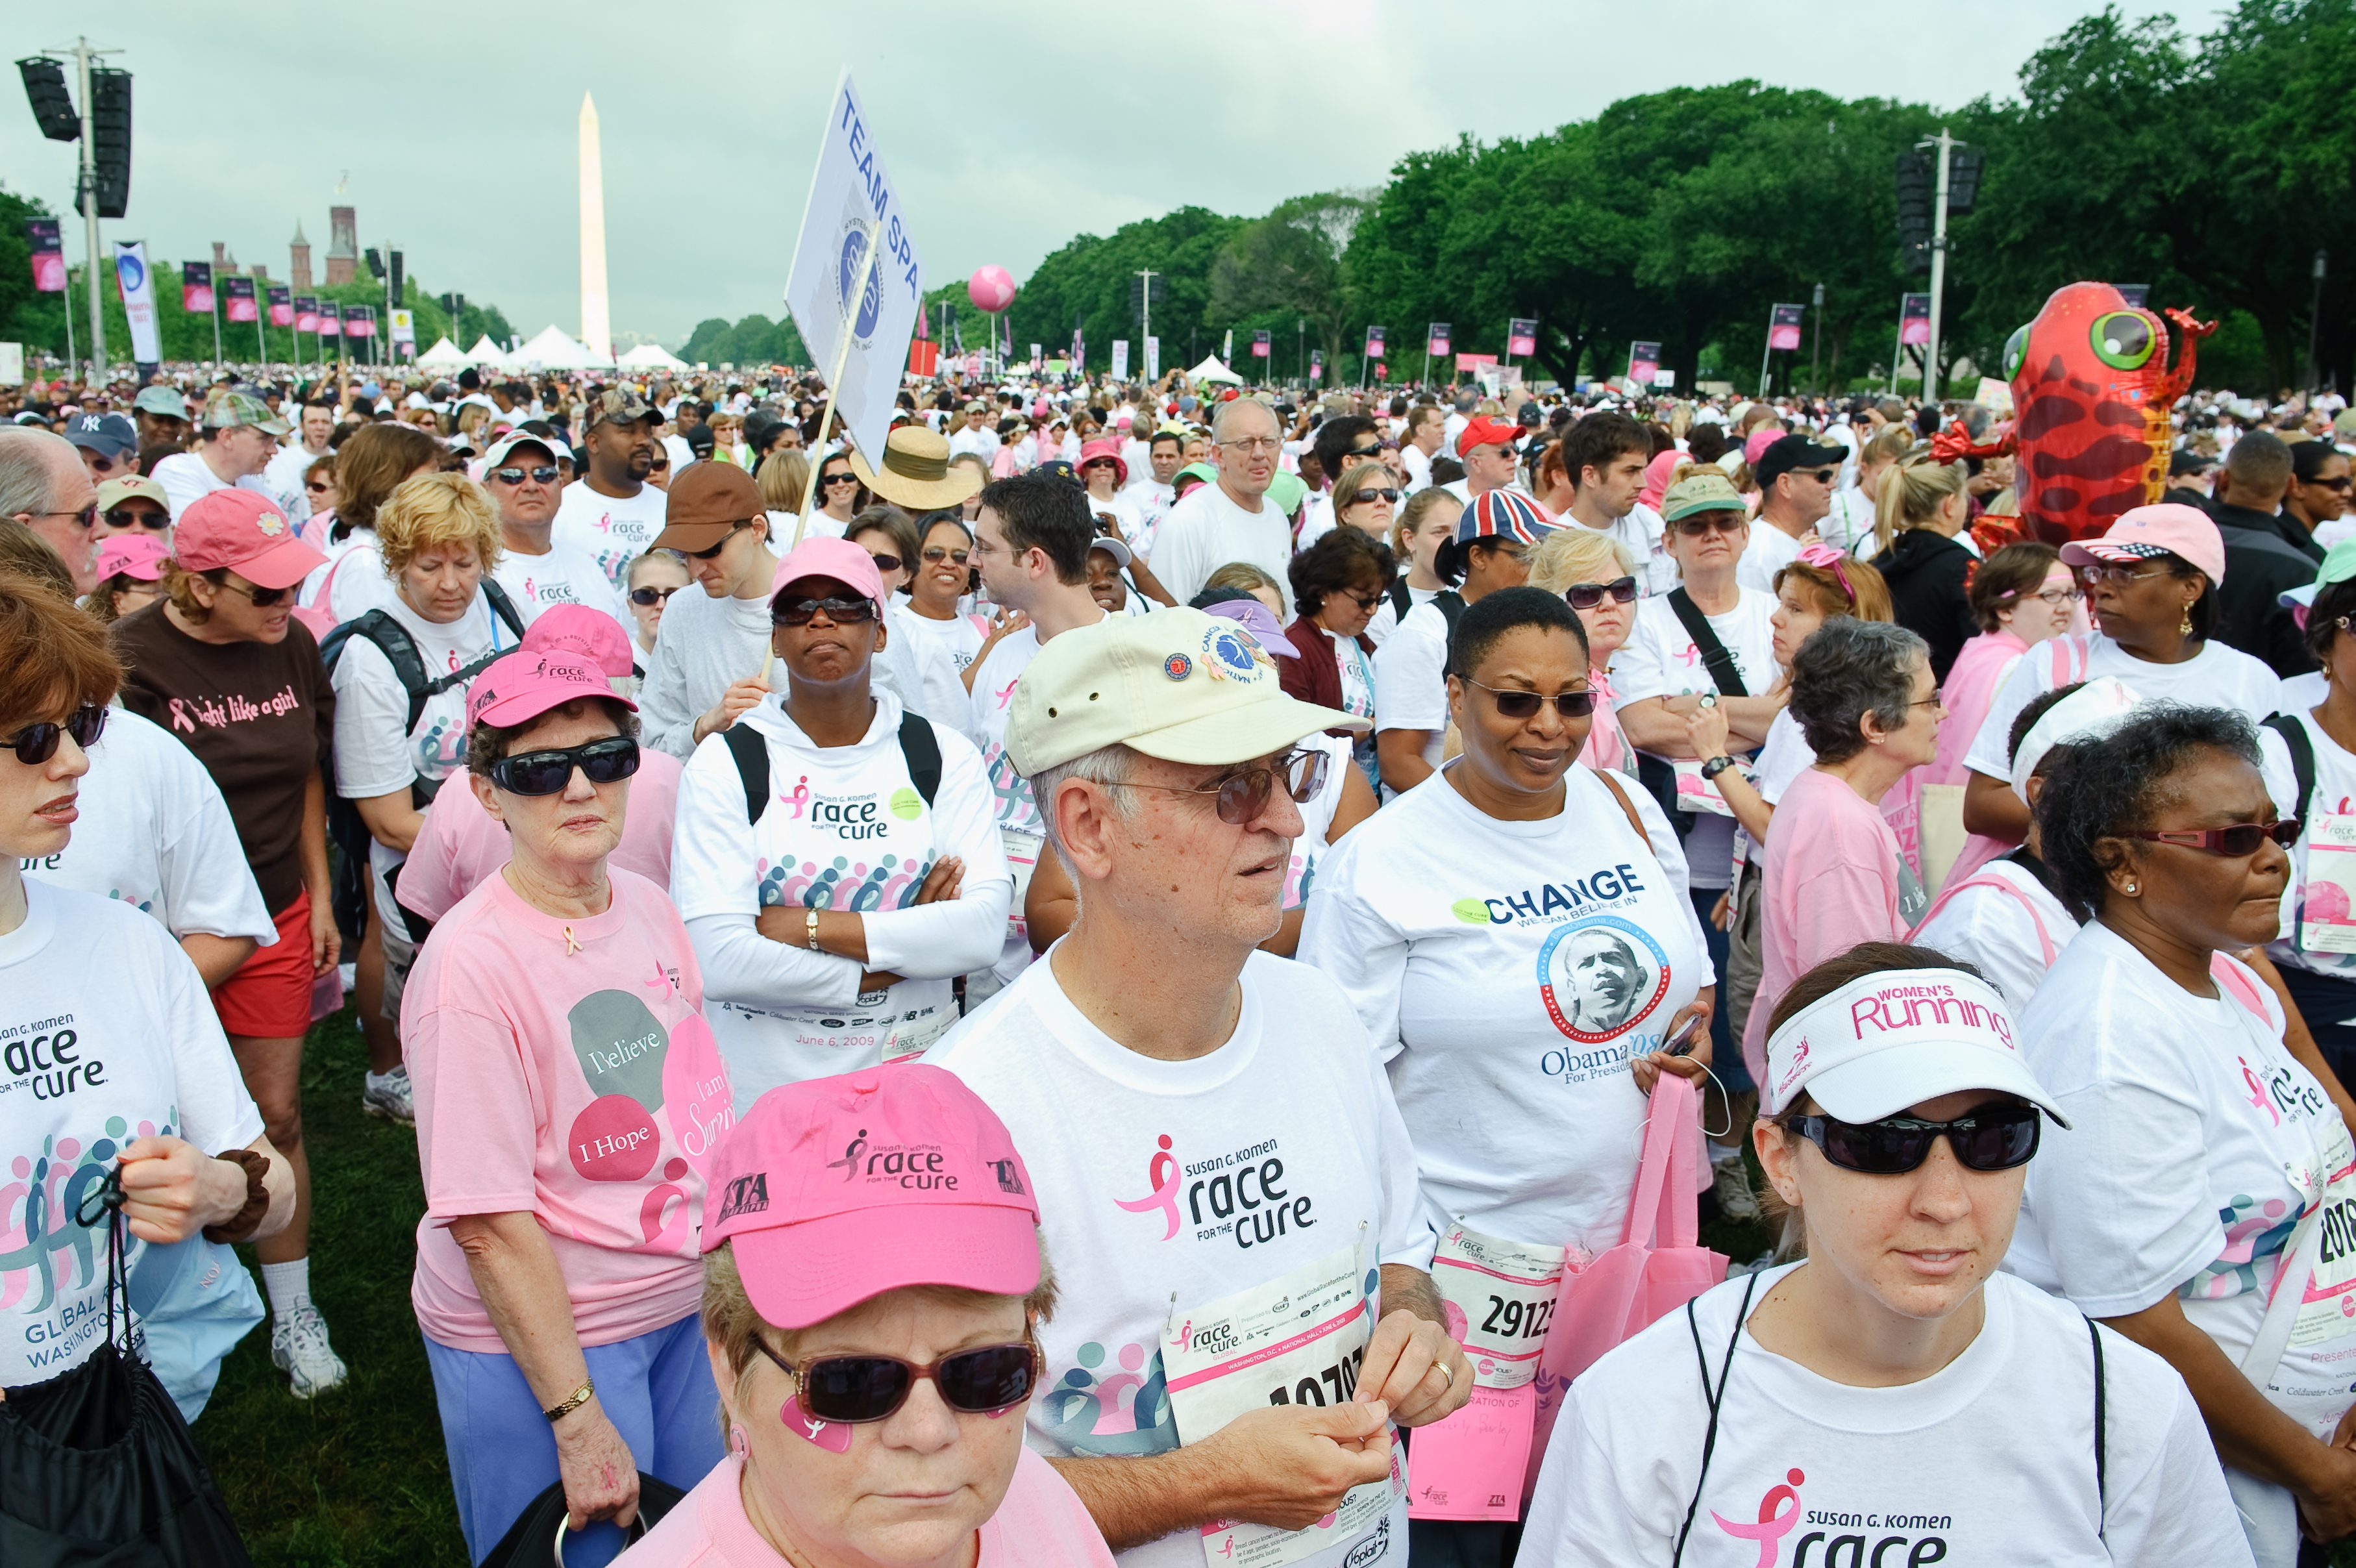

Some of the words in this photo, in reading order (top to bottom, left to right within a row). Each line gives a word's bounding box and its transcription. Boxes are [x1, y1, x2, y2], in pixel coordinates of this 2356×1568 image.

[842, 89, 888, 221] TEAM
[888, 215, 917, 301] SPA
[81, 414, 101, 432] NY
[613, 523, 644, 534] race
[627, 534, 652, 542] cure
[540, 585, 572, 600] race
[550, 667, 586, 677] race
[566, 675, 593, 684] cure
[227, 694, 260, 722] like
[261, 701, 272, 715] a
[271, 684, 299, 717] girl
[812, 801, 876, 823] race
[839, 823, 889, 840] cure
[1484, 864, 1645, 925] CHANGE
[1517, 917, 1538, 928] WE
[1538, 914, 1569, 925] CAN
[1624, 895, 1638, 907] IN
[1878, 985, 1953, 1001] WOMEN'S
[769, 1011, 797, 1023] Coldwater
[1852, 997, 2015, 1050] Running
[796, 1035, 825, 1046] June
[828, 1037, 839, 1047] 6,
[843, 1036, 874, 1047] 2009
[4, 1029, 79, 1076] ace
[1541, 1044, 1628, 1076] Obama
[1565, 1073, 1586, 1084] For
[1591, 1061, 1633, 1079] Preside
[0, 1084, 12, 1093] OR
[13, 1078, 30, 1089] THE
[695, 1080, 707, 1102] I
[705, 1074, 725, 1094] am
[684, 1097, 737, 1156] Surviv
[578, 1143, 591, 1164] I
[593, 1126, 651, 1159] Hope
[867, 1152, 944, 1175] race
[1225, 1154, 1235, 1166] G.
[900, 1175, 959, 1191] cure
[1189, 1158, 1287, 1225] race
[1197, 1231, 1217, 1241] FOR
[1217, 1222, 1232, 1236] THE
[1458, 1239, 1483, 1254] race
[1241, 1311, 1265, 1323] Presented
[1193, 1324, 1231, 1348] race
[1213, 1349, 1237, 1361] GLOBAL
[1228, 1352, 1267, 1371] WASHINGTON,
[1267, 1348, 1278, 1356] D.C.
[1282, 1336, 1307, 1350] NATIONAL
[2311, 1347, 2356, 1363] Presente
[2287, 1387, 2326, 1397] Coldwater
[1470, 1397, 1505, 1407] RATION
[1507, 1399, 1520, 1408] OF
[1489, 1495, 1506, 1503] ZTA
[1866, 1513, 1881, 1528] G.
[1235, 1541, 1247, 1550] Breast
[1248, 1537, 1260, 1546] cancer
[1246, 1548, 1256, 1556] age,
[1255, 1543, 1270, 1553] gender,
[1792, 1532, 1947, 1568] race
[1243, 1552, 1265, 1564] geographic
[1265, 1547, 1282, 1556] location.
[1348, 1539, 1378, 1568] Yoplait
